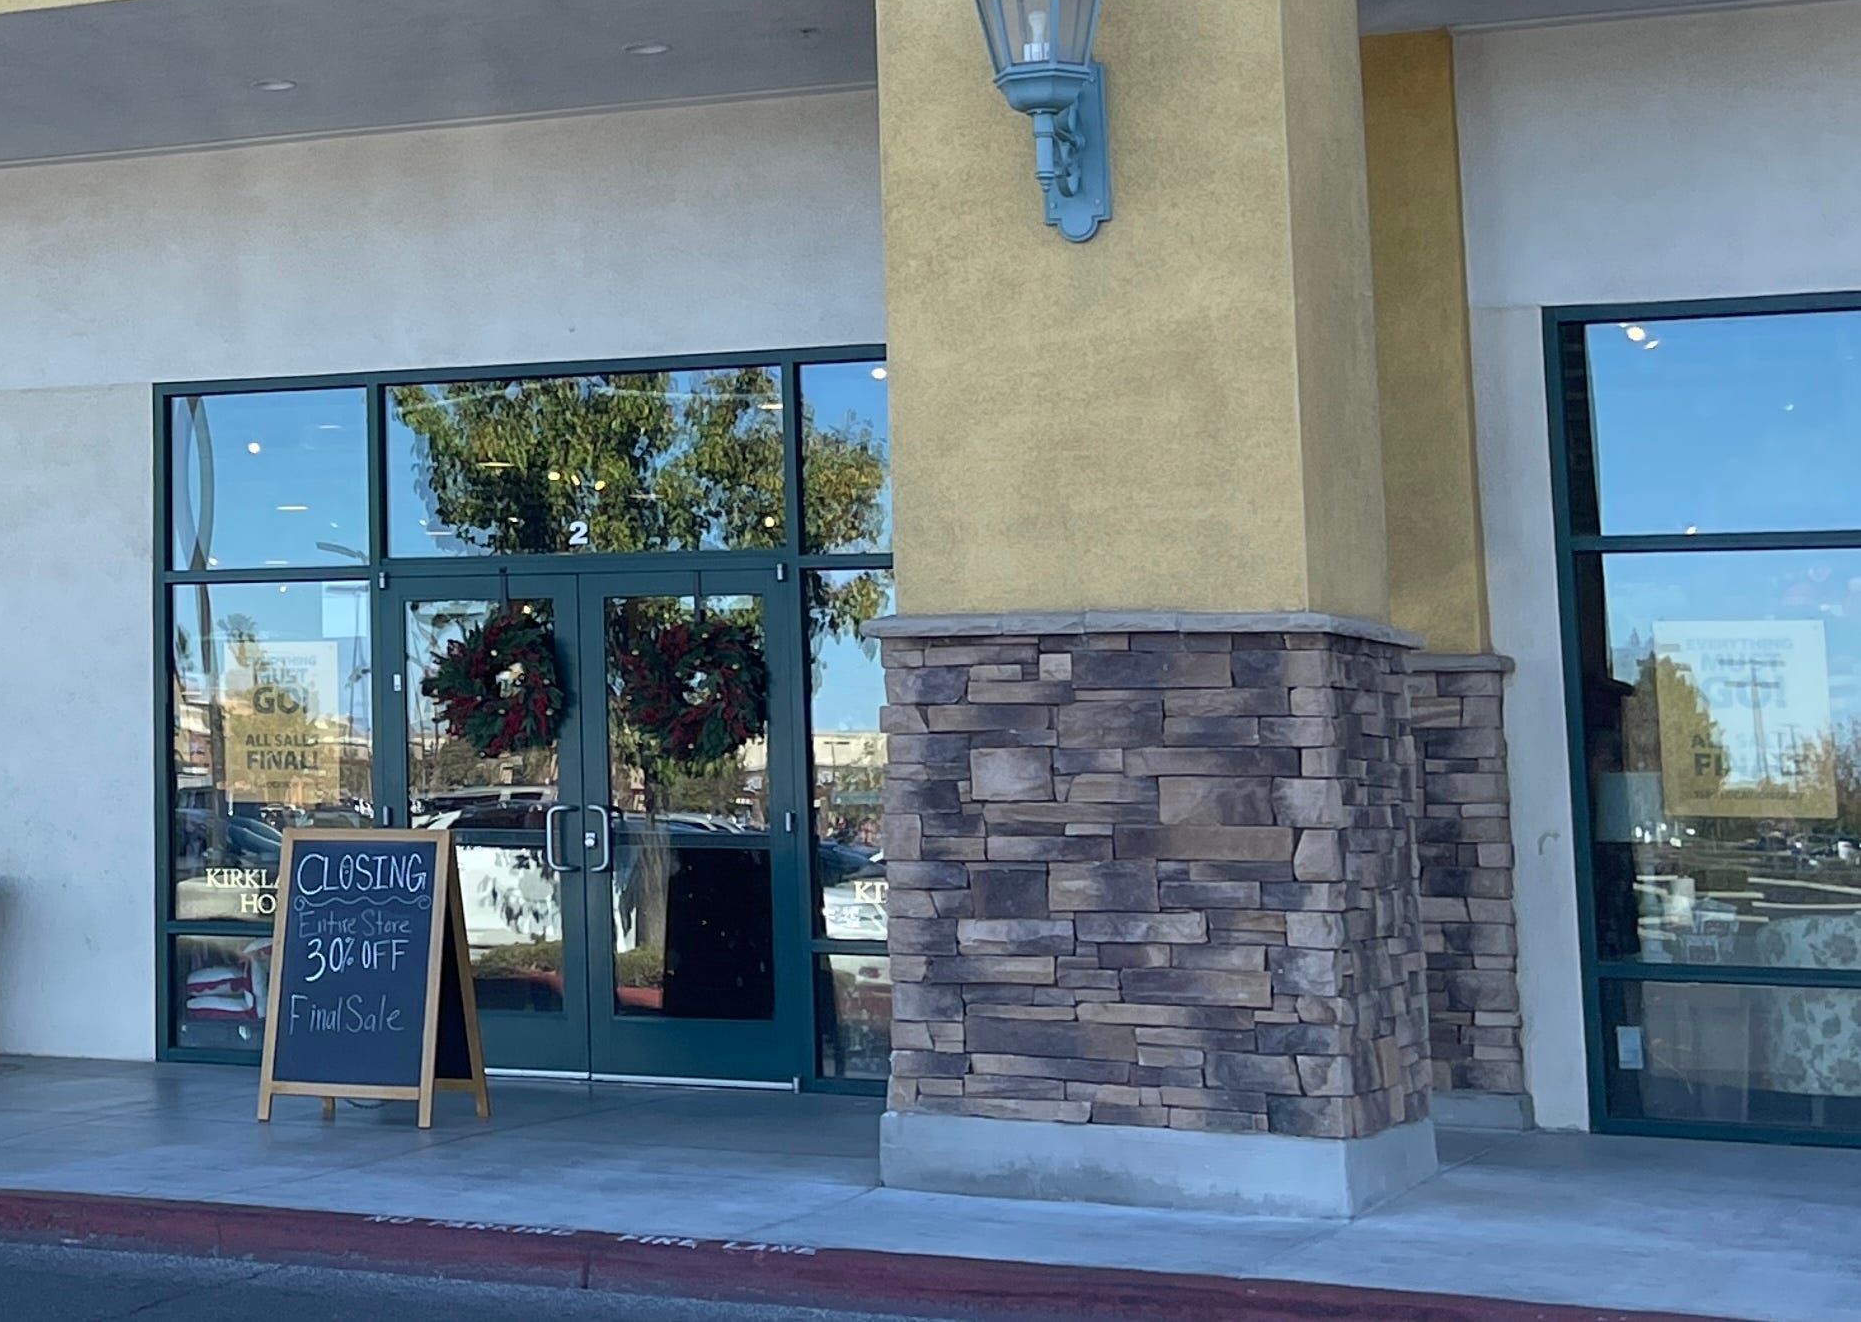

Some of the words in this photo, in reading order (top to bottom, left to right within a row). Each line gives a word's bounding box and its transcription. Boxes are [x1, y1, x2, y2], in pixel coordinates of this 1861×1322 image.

[569, 521, 588, 546] 2
[253, 686, 309, 714] GO!
[246, 734, 272, 747] ALL
[247, 750, 319, 771] FINAL!
[297, 853, 427, 895] CLOSING
[240, 894, 276, 915] HO
[854, 881, 888, 904] KI
[299, 910, 358, 938] Entire
[361, 908, 413, 937] Store
[305, 936, 356, 982] 30%
[361, 939, 410, 971] OFF
[289, 994, 343, 1035] Final
[345, 993, 406, 1033] Sale
